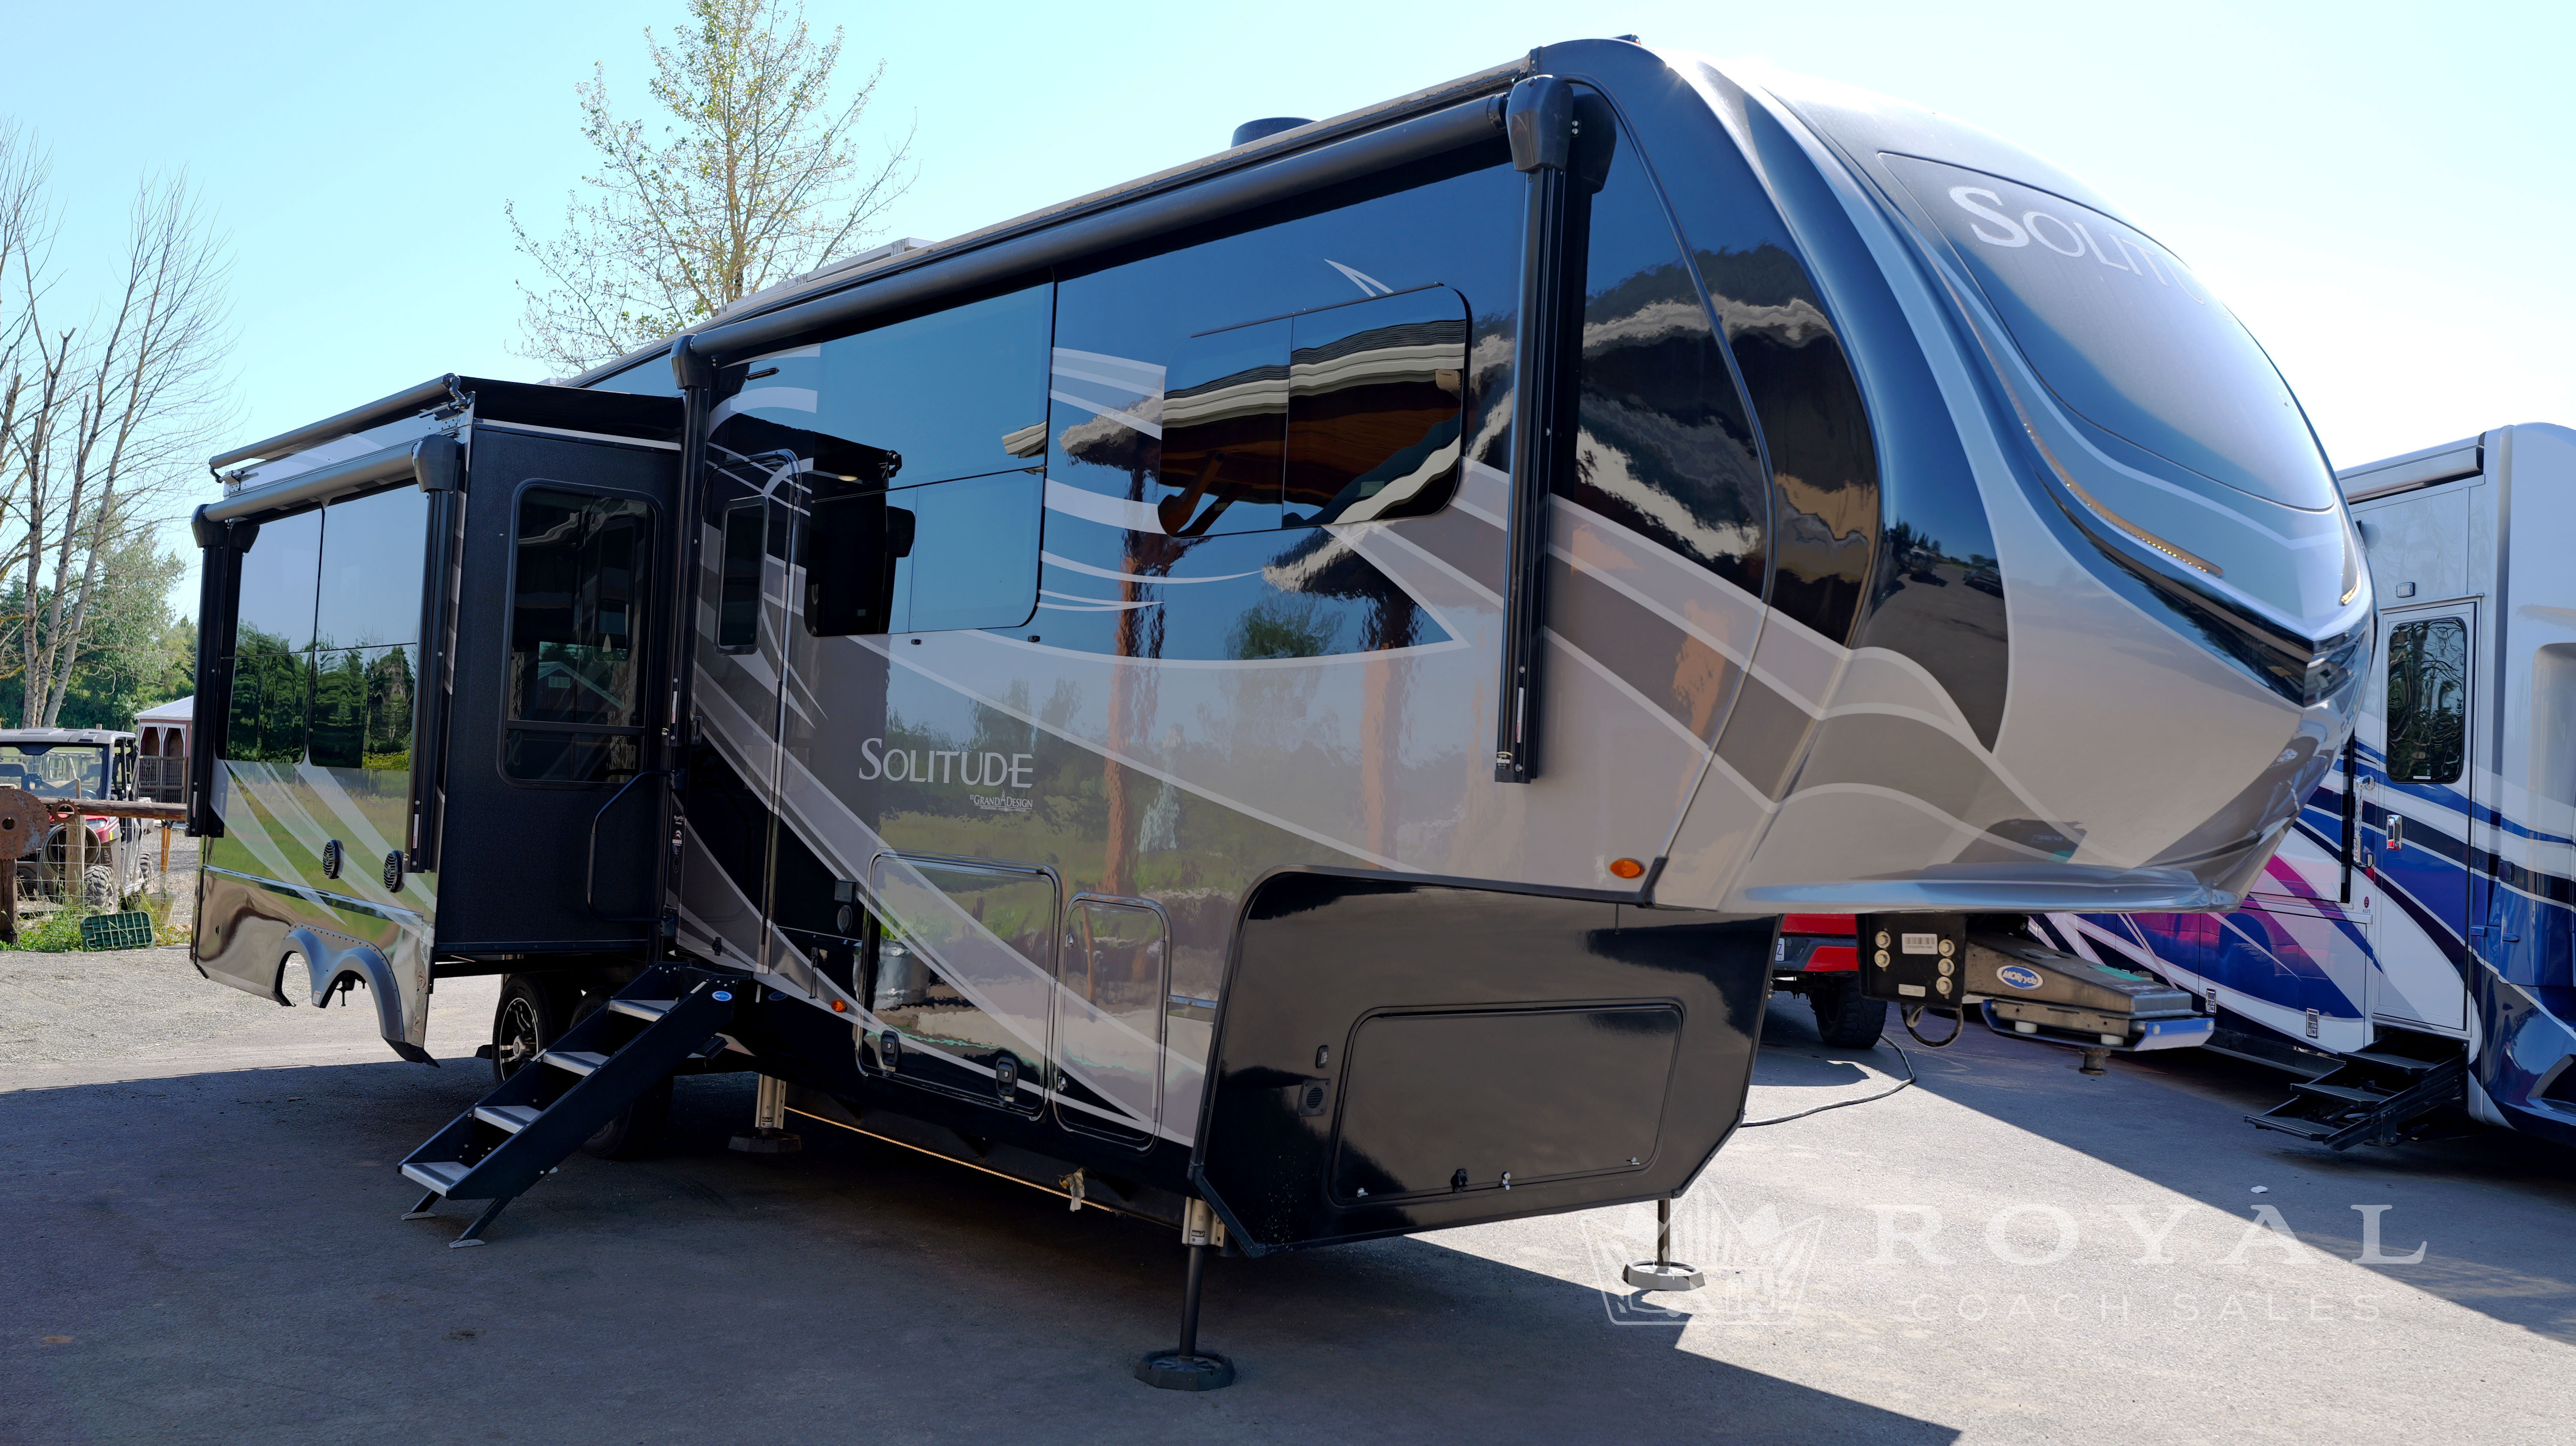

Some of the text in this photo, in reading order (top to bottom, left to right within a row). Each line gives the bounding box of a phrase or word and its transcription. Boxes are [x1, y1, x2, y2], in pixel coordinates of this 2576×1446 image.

[859, 738, 1033, 788] SOLITUDE
[974, 794, 1000, 806] GRAND
[1006, 796, 1033, 808] DESIGN
